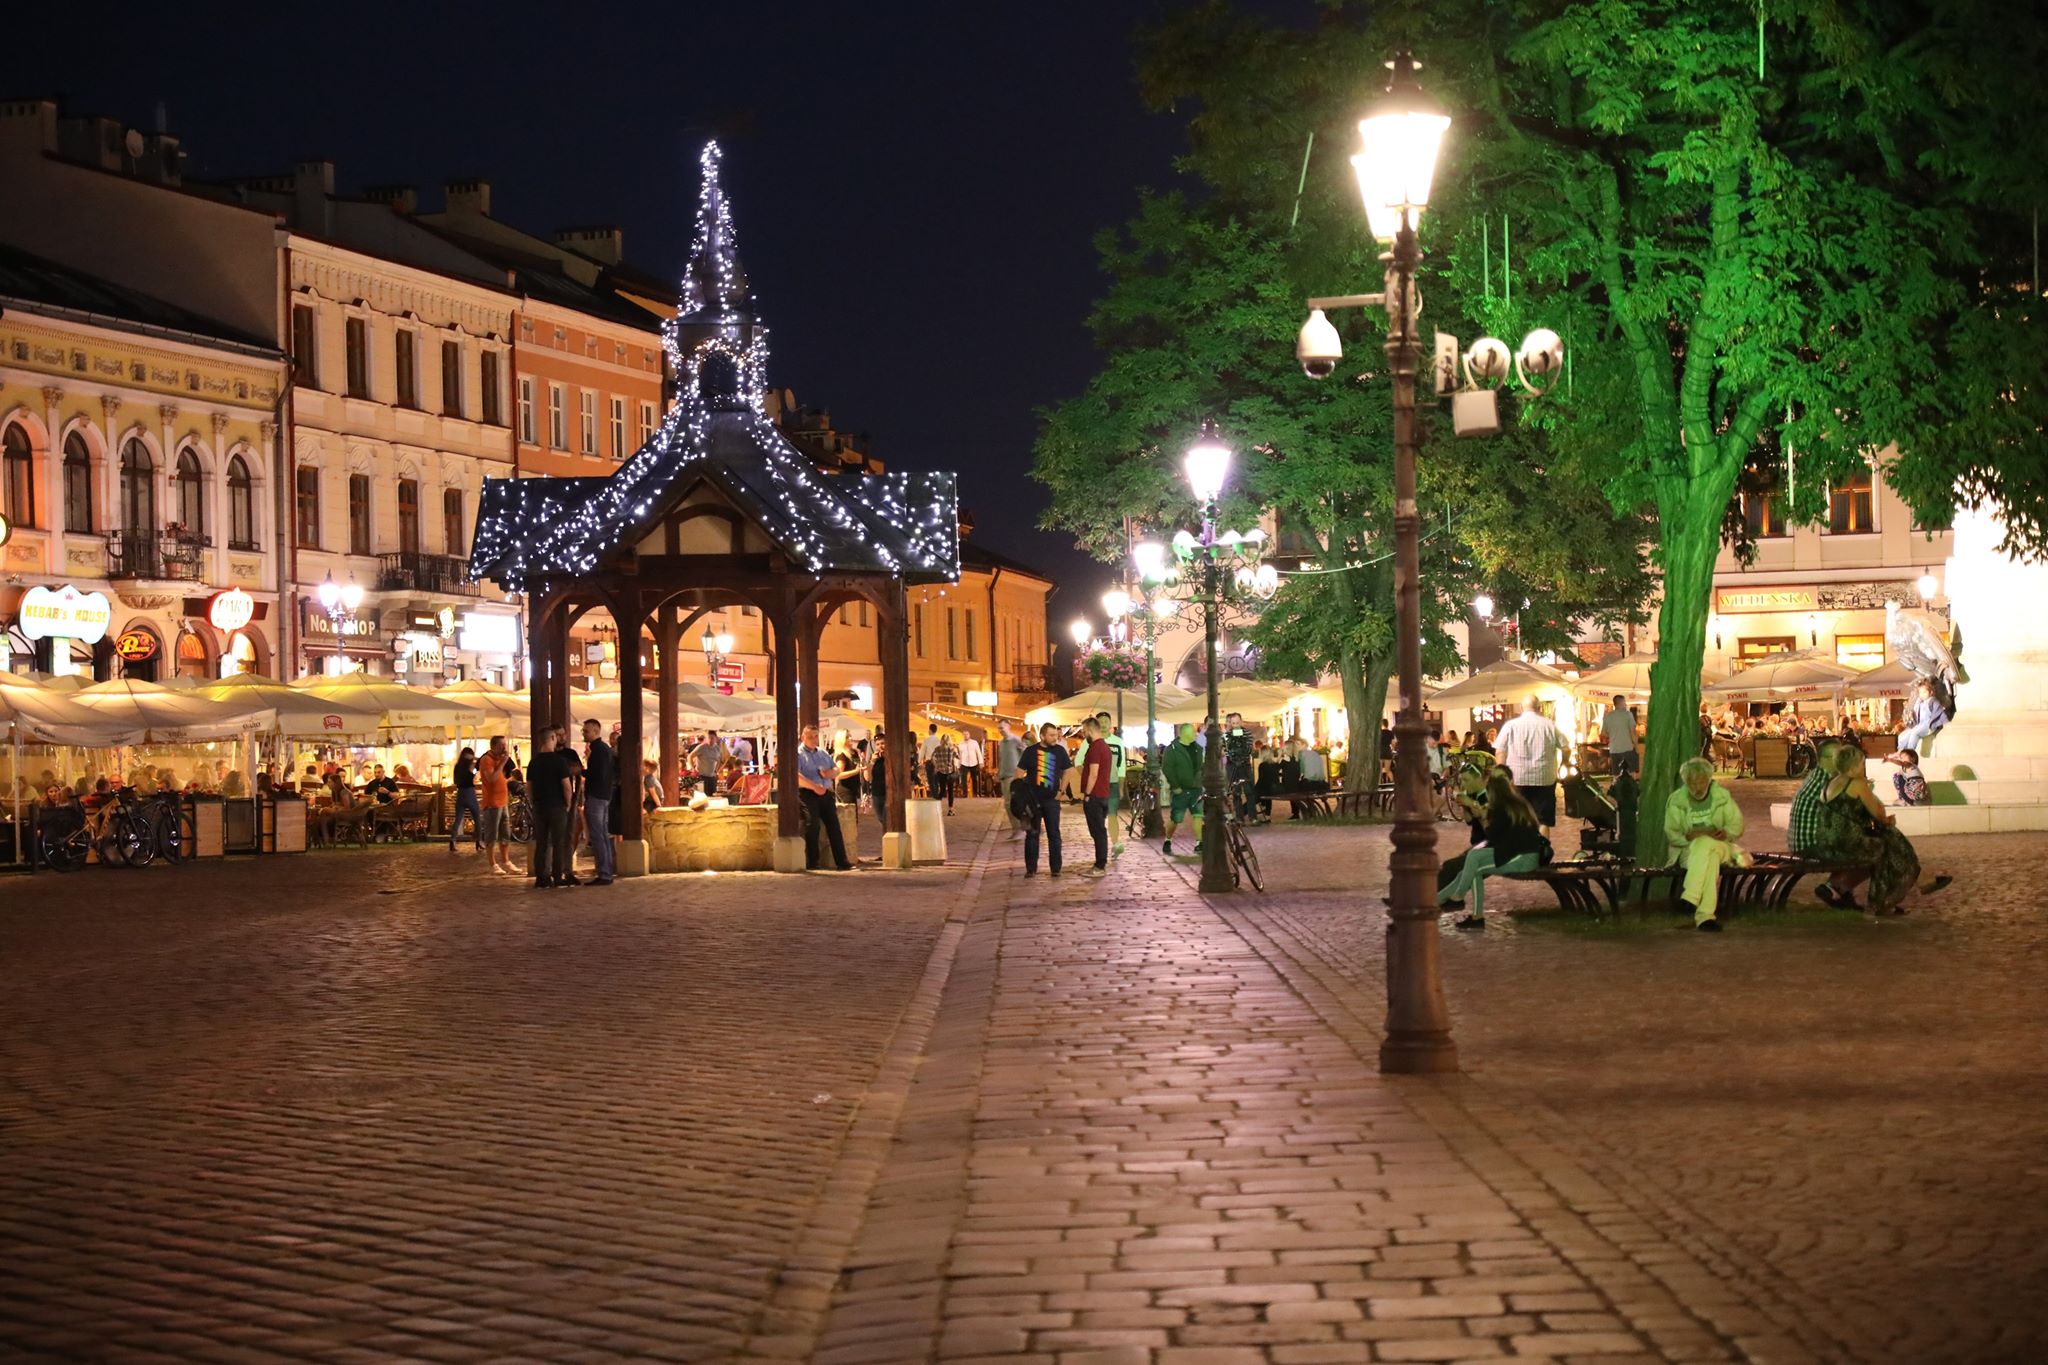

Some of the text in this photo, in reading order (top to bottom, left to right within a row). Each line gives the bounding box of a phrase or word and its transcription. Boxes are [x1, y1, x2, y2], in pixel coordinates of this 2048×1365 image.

[74, 609, 107, 623] HOUSE
[310, 614, 330, 633] No.
[418, 650, 440, 663] BOSS
